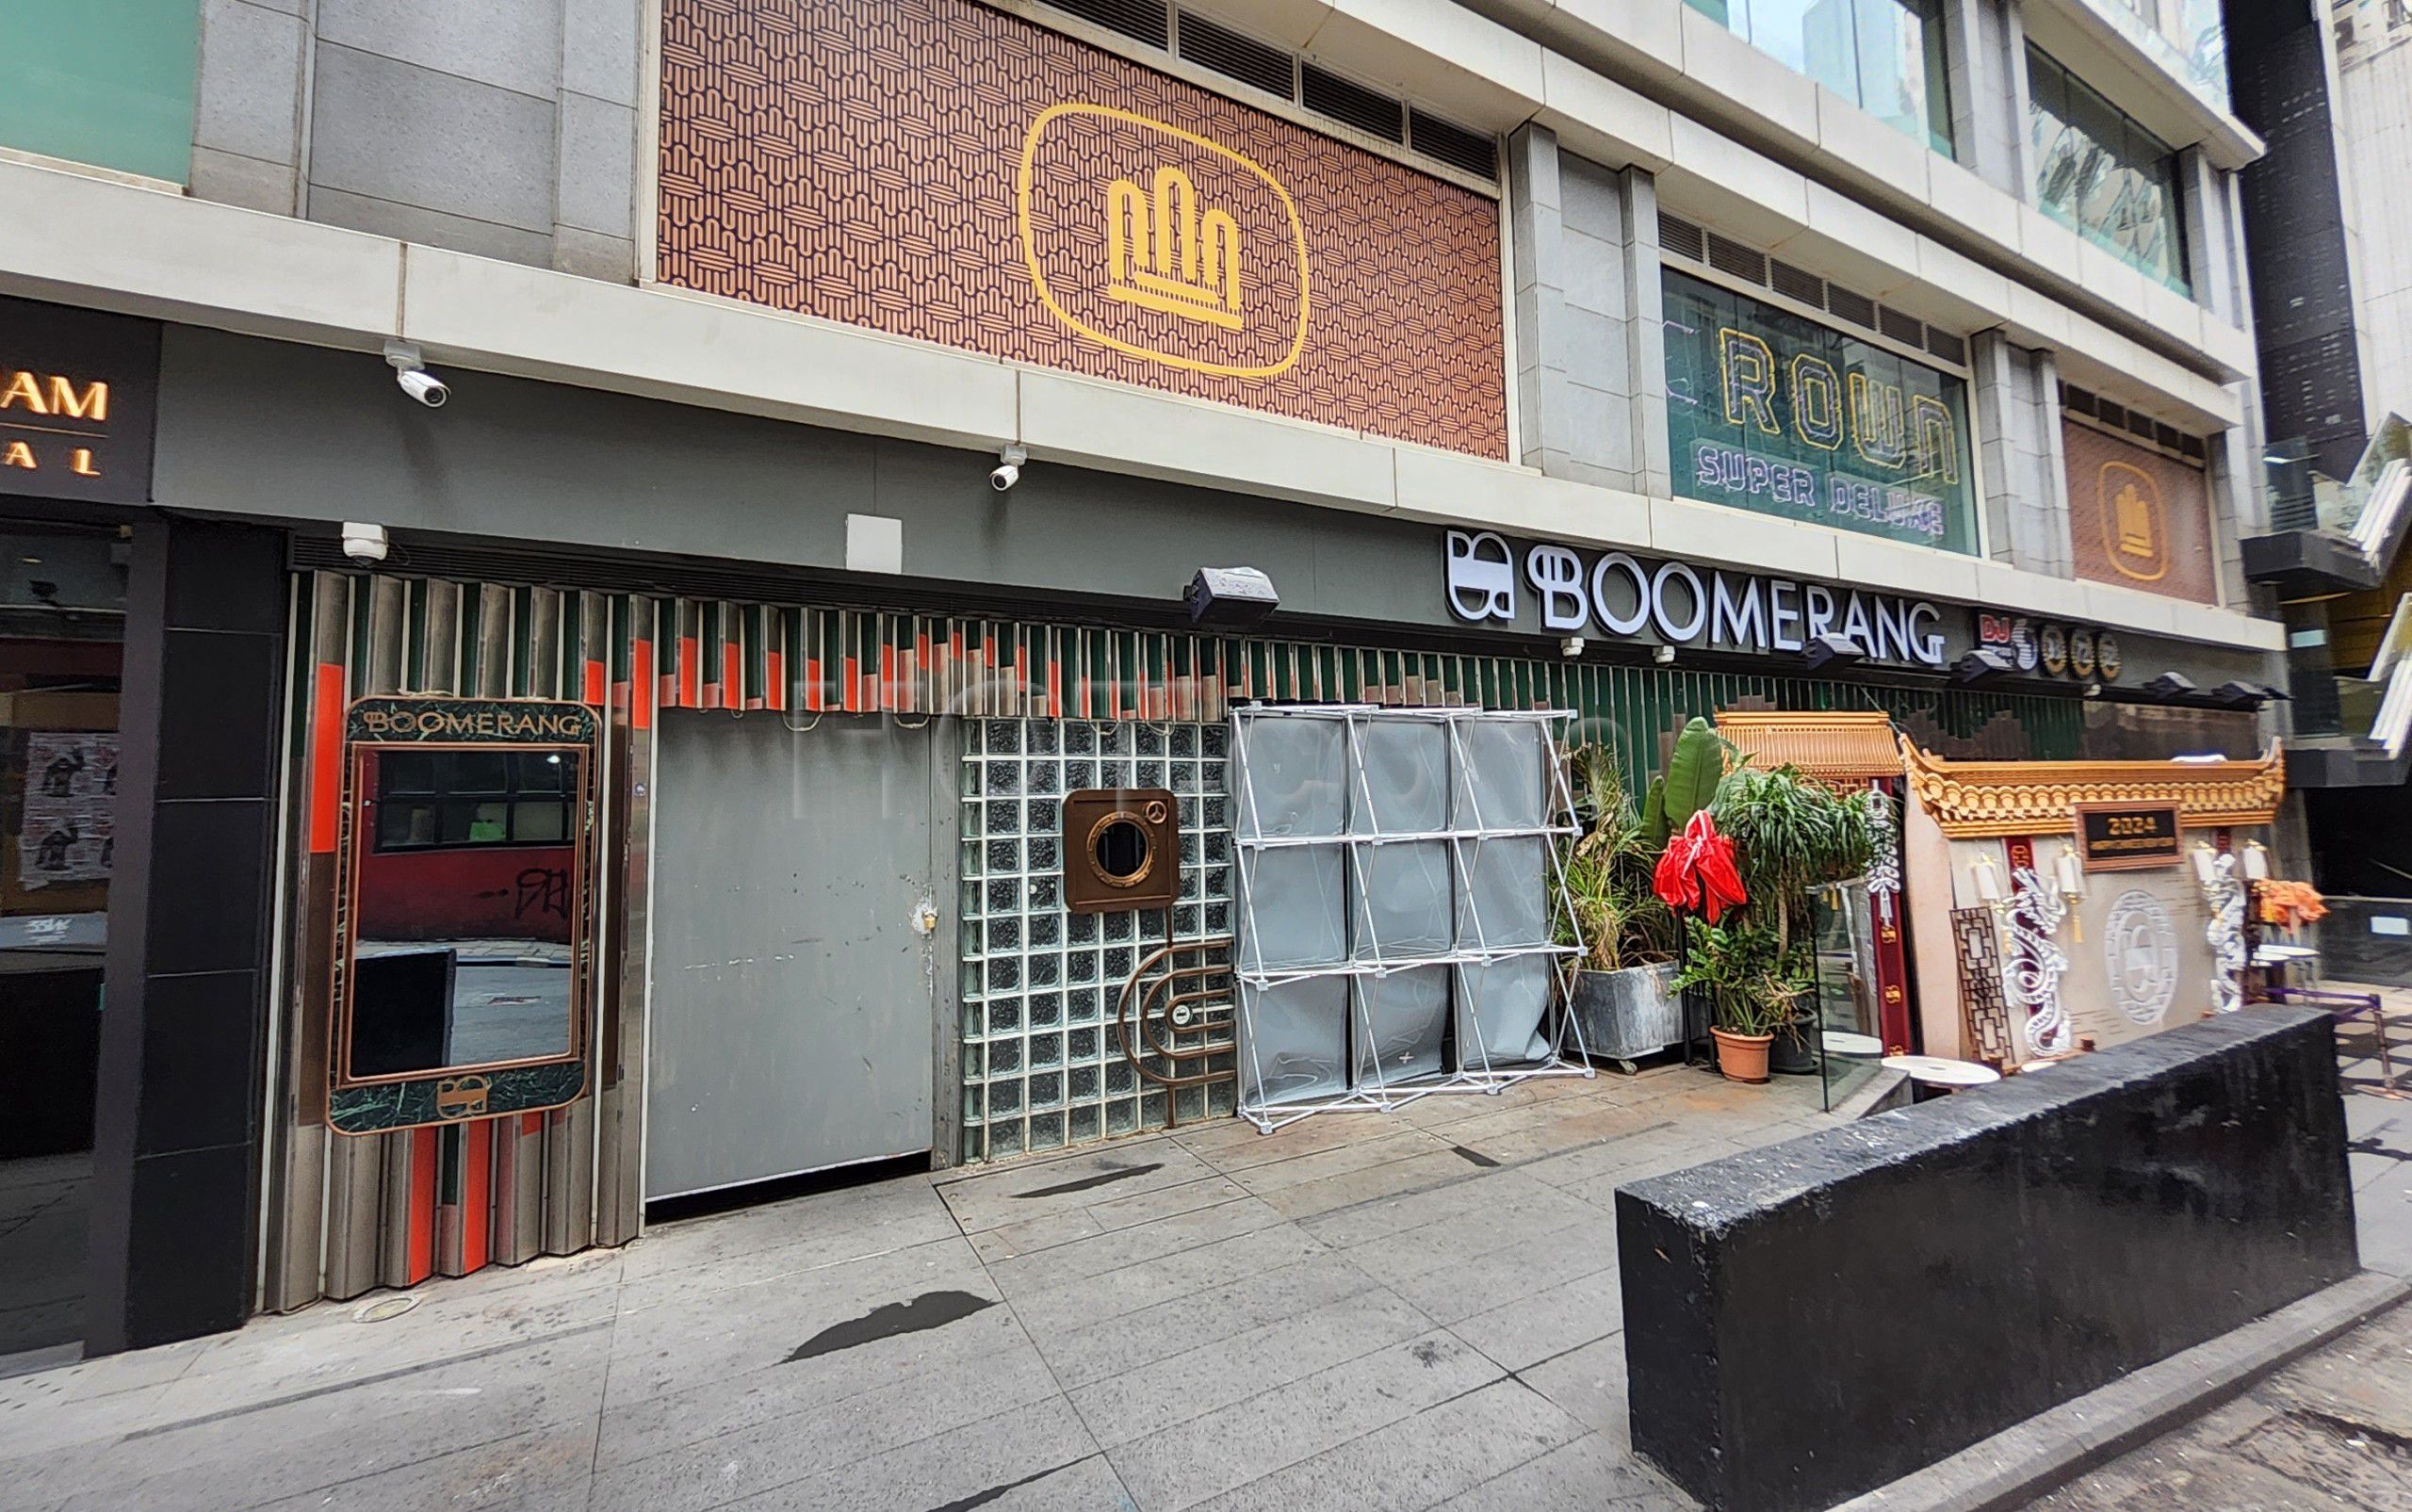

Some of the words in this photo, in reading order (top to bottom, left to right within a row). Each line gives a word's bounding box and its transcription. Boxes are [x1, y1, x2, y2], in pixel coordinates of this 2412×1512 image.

[1697, 445, 1816, 507] SUPER
[1524, 544, 1946, 665] BOOMERANG
[363, 709, 582, 736] BOOMERANG
